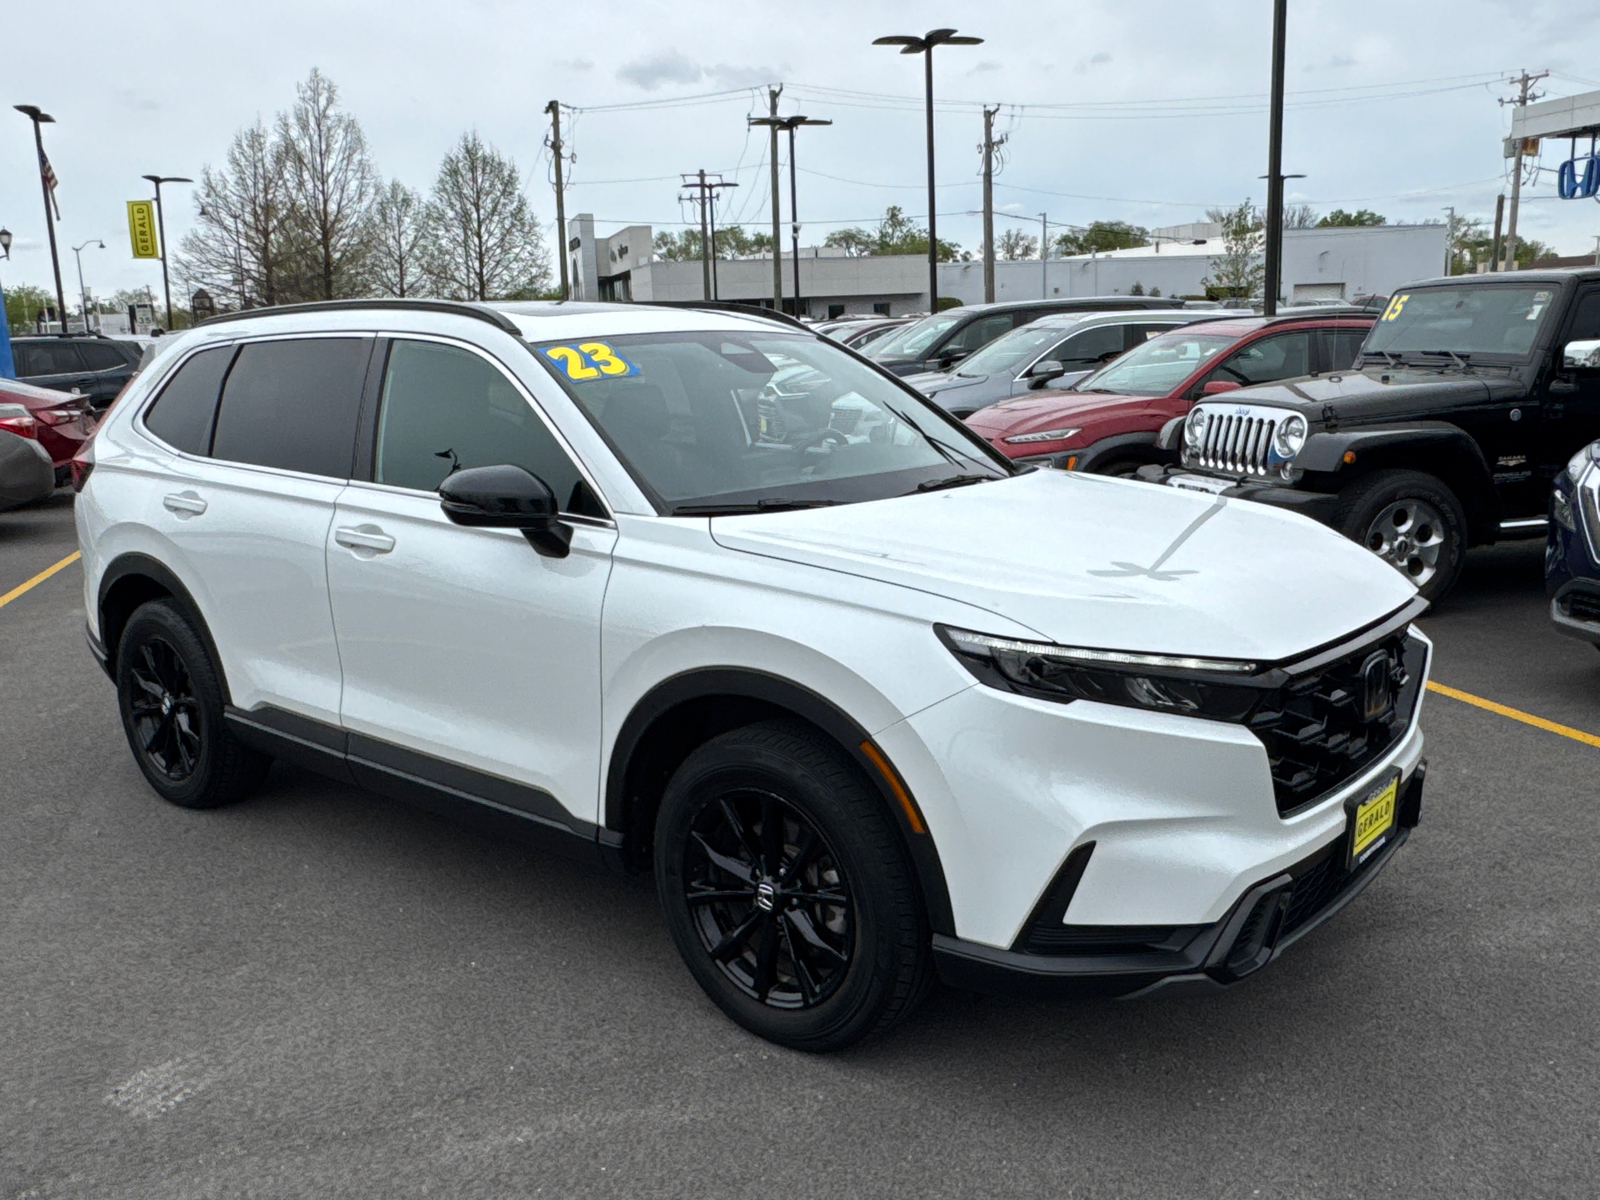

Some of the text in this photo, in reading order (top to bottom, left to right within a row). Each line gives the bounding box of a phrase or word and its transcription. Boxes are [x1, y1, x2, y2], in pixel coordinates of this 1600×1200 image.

[136, 207, 150, 252] GERALD
[138, 316, 151, 325] 35
[1381, 294, 1410, 321] 15
[546, 342, 630, 380] 23
[1358, 800, 1390, 838] GERALD
